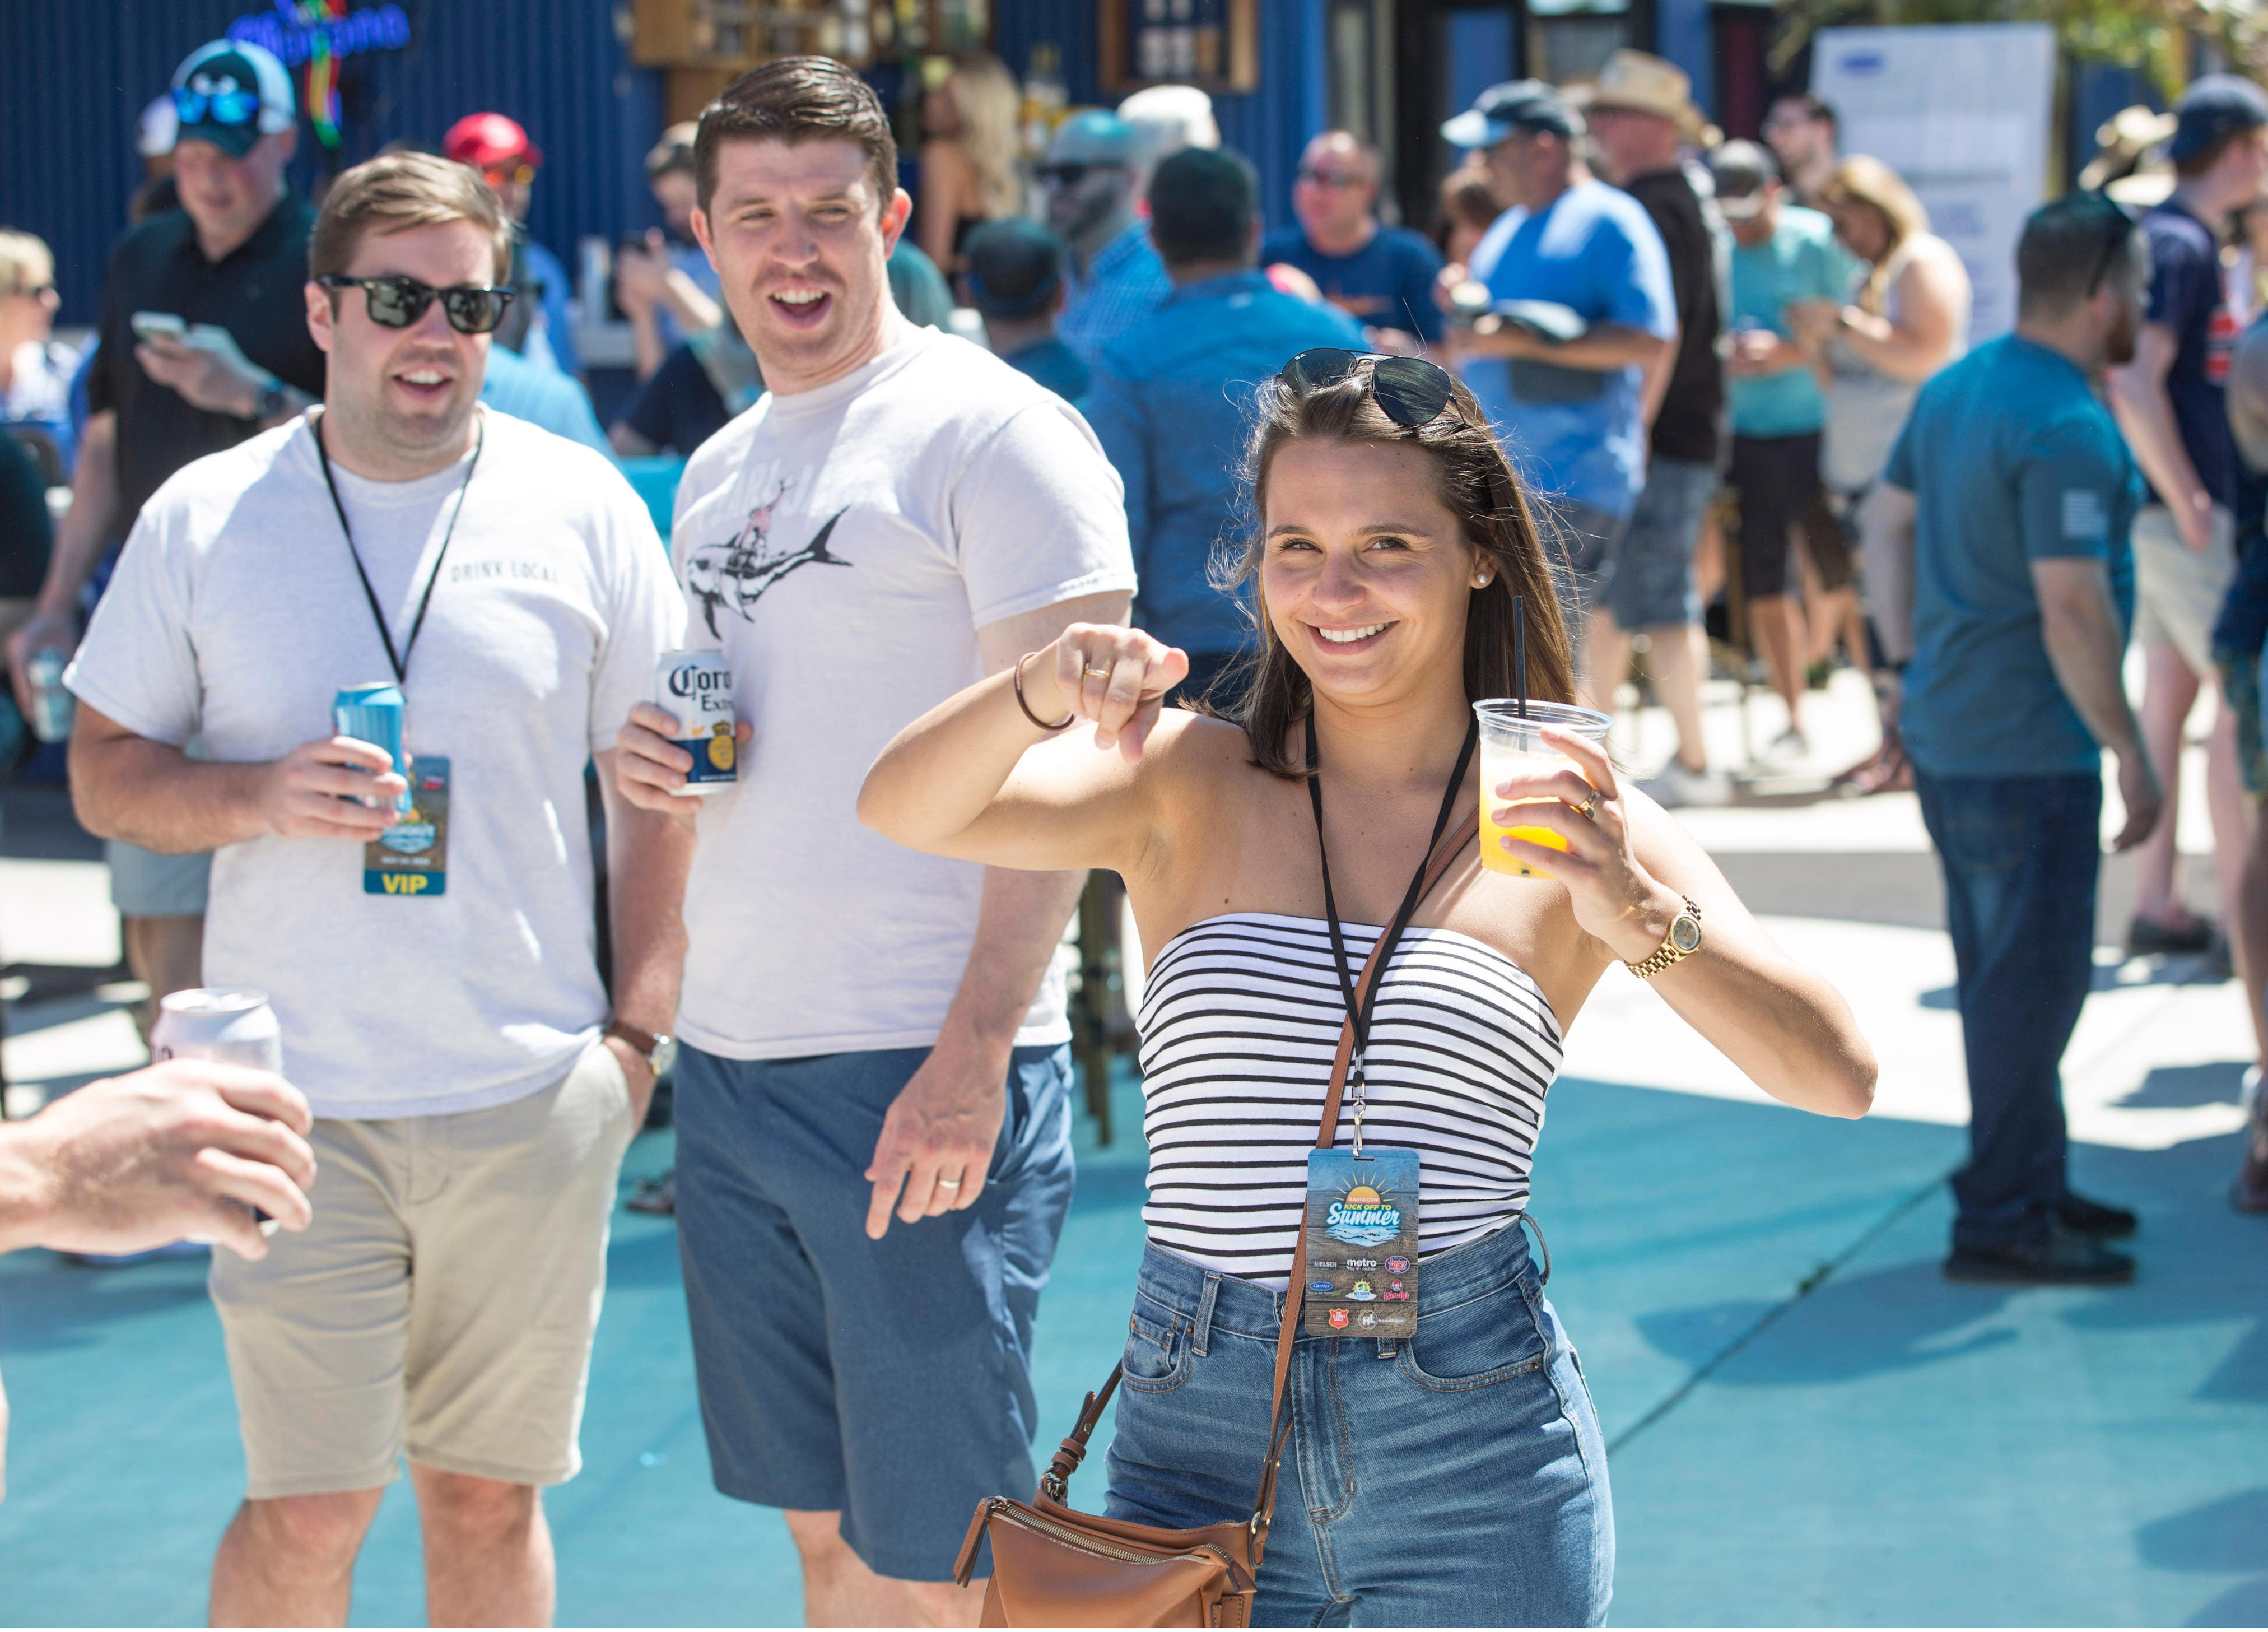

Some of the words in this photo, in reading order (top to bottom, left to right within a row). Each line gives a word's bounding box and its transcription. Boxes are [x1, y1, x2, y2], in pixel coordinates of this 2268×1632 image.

[451, 561, 503, 583] DRINK
[381, 873, 429, 894] VIP
[1326, 1202, 1400, 1226] Summer
[1347, 1258, 1377, 1267] metro
[1384, 1288, 1410, 1301] Wendy's
